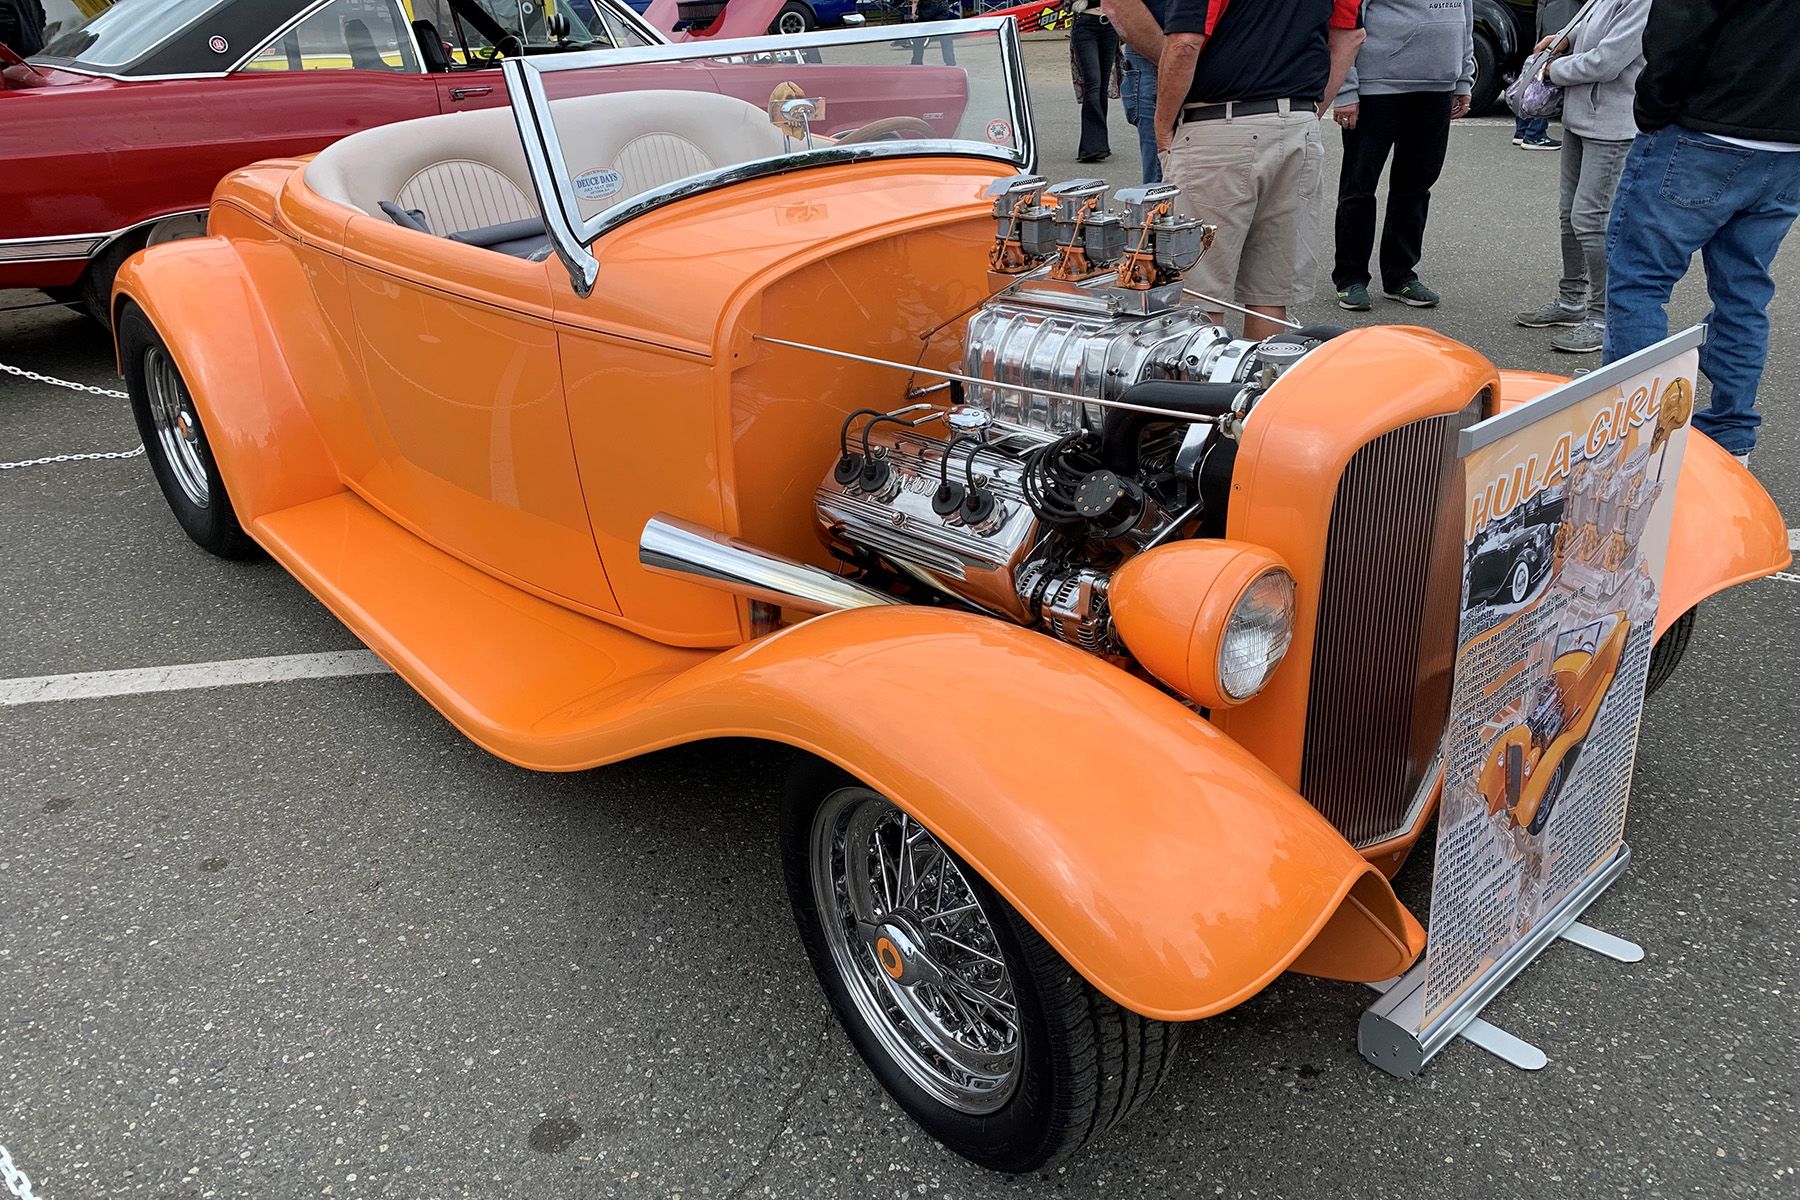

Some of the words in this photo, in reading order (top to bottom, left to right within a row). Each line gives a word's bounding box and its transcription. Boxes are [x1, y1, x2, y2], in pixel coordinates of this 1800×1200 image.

[576, 177, 600, 188] DEUCE
[600, 173, 618, 183] DAYS
[1467, 433, 1572, 542] HULA
[1583, 377, 1661, 459] GIRL
